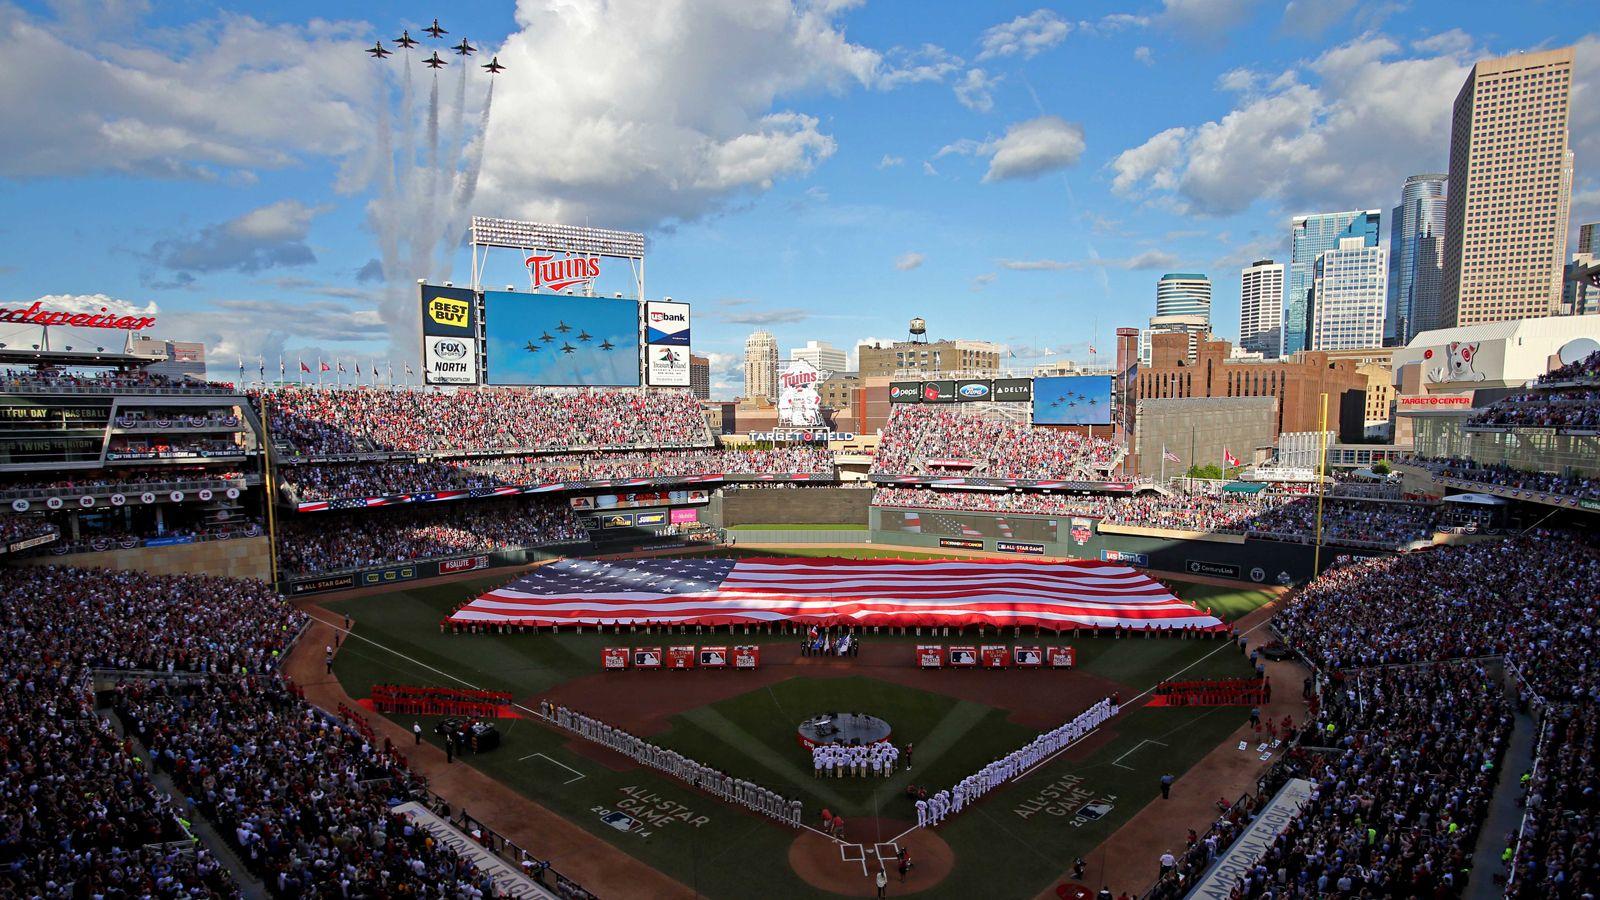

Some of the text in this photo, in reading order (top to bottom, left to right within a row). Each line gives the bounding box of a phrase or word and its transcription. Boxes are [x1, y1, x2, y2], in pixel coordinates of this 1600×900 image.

[526, 252, 600, 288] Twins
[434, 302, 467, 314] BEST
[0, 302, 155, 330] dweiser
[436, 311, 464, 322] BUY
[441, 343, 460, 352] FOX
[435, 362, 467, 372] NORTH
[780, 371, 817, 388] Twins
[963, 386, 983, 395] Ford
[31, 409, 47, 418] DAY
[65, 409, 106, 418] BASEBALL
[18, 441, 50, 451] TWINS
[446, 560, 469, 569] #SALUTE
[1202, 566, 1234, 574] CenturyLink
[305, 577, 352, 590] ALL STAR GAME
[1013, 774, 1084, 819] ALL STAR
[1046, 788, 1094, 816] GAME
[589, 805, 611, 816] 20
[619, 785, 710, 828] ALL STAR
[616, 798, 675, 828] GAME
[1070, 816, 1088, 827] 20
[1255, 804, 1296, 843] LEAGUE
[423, 820, 488, 867] NATIONAL
[1203, 839, 1263, 900] AMERICAN
